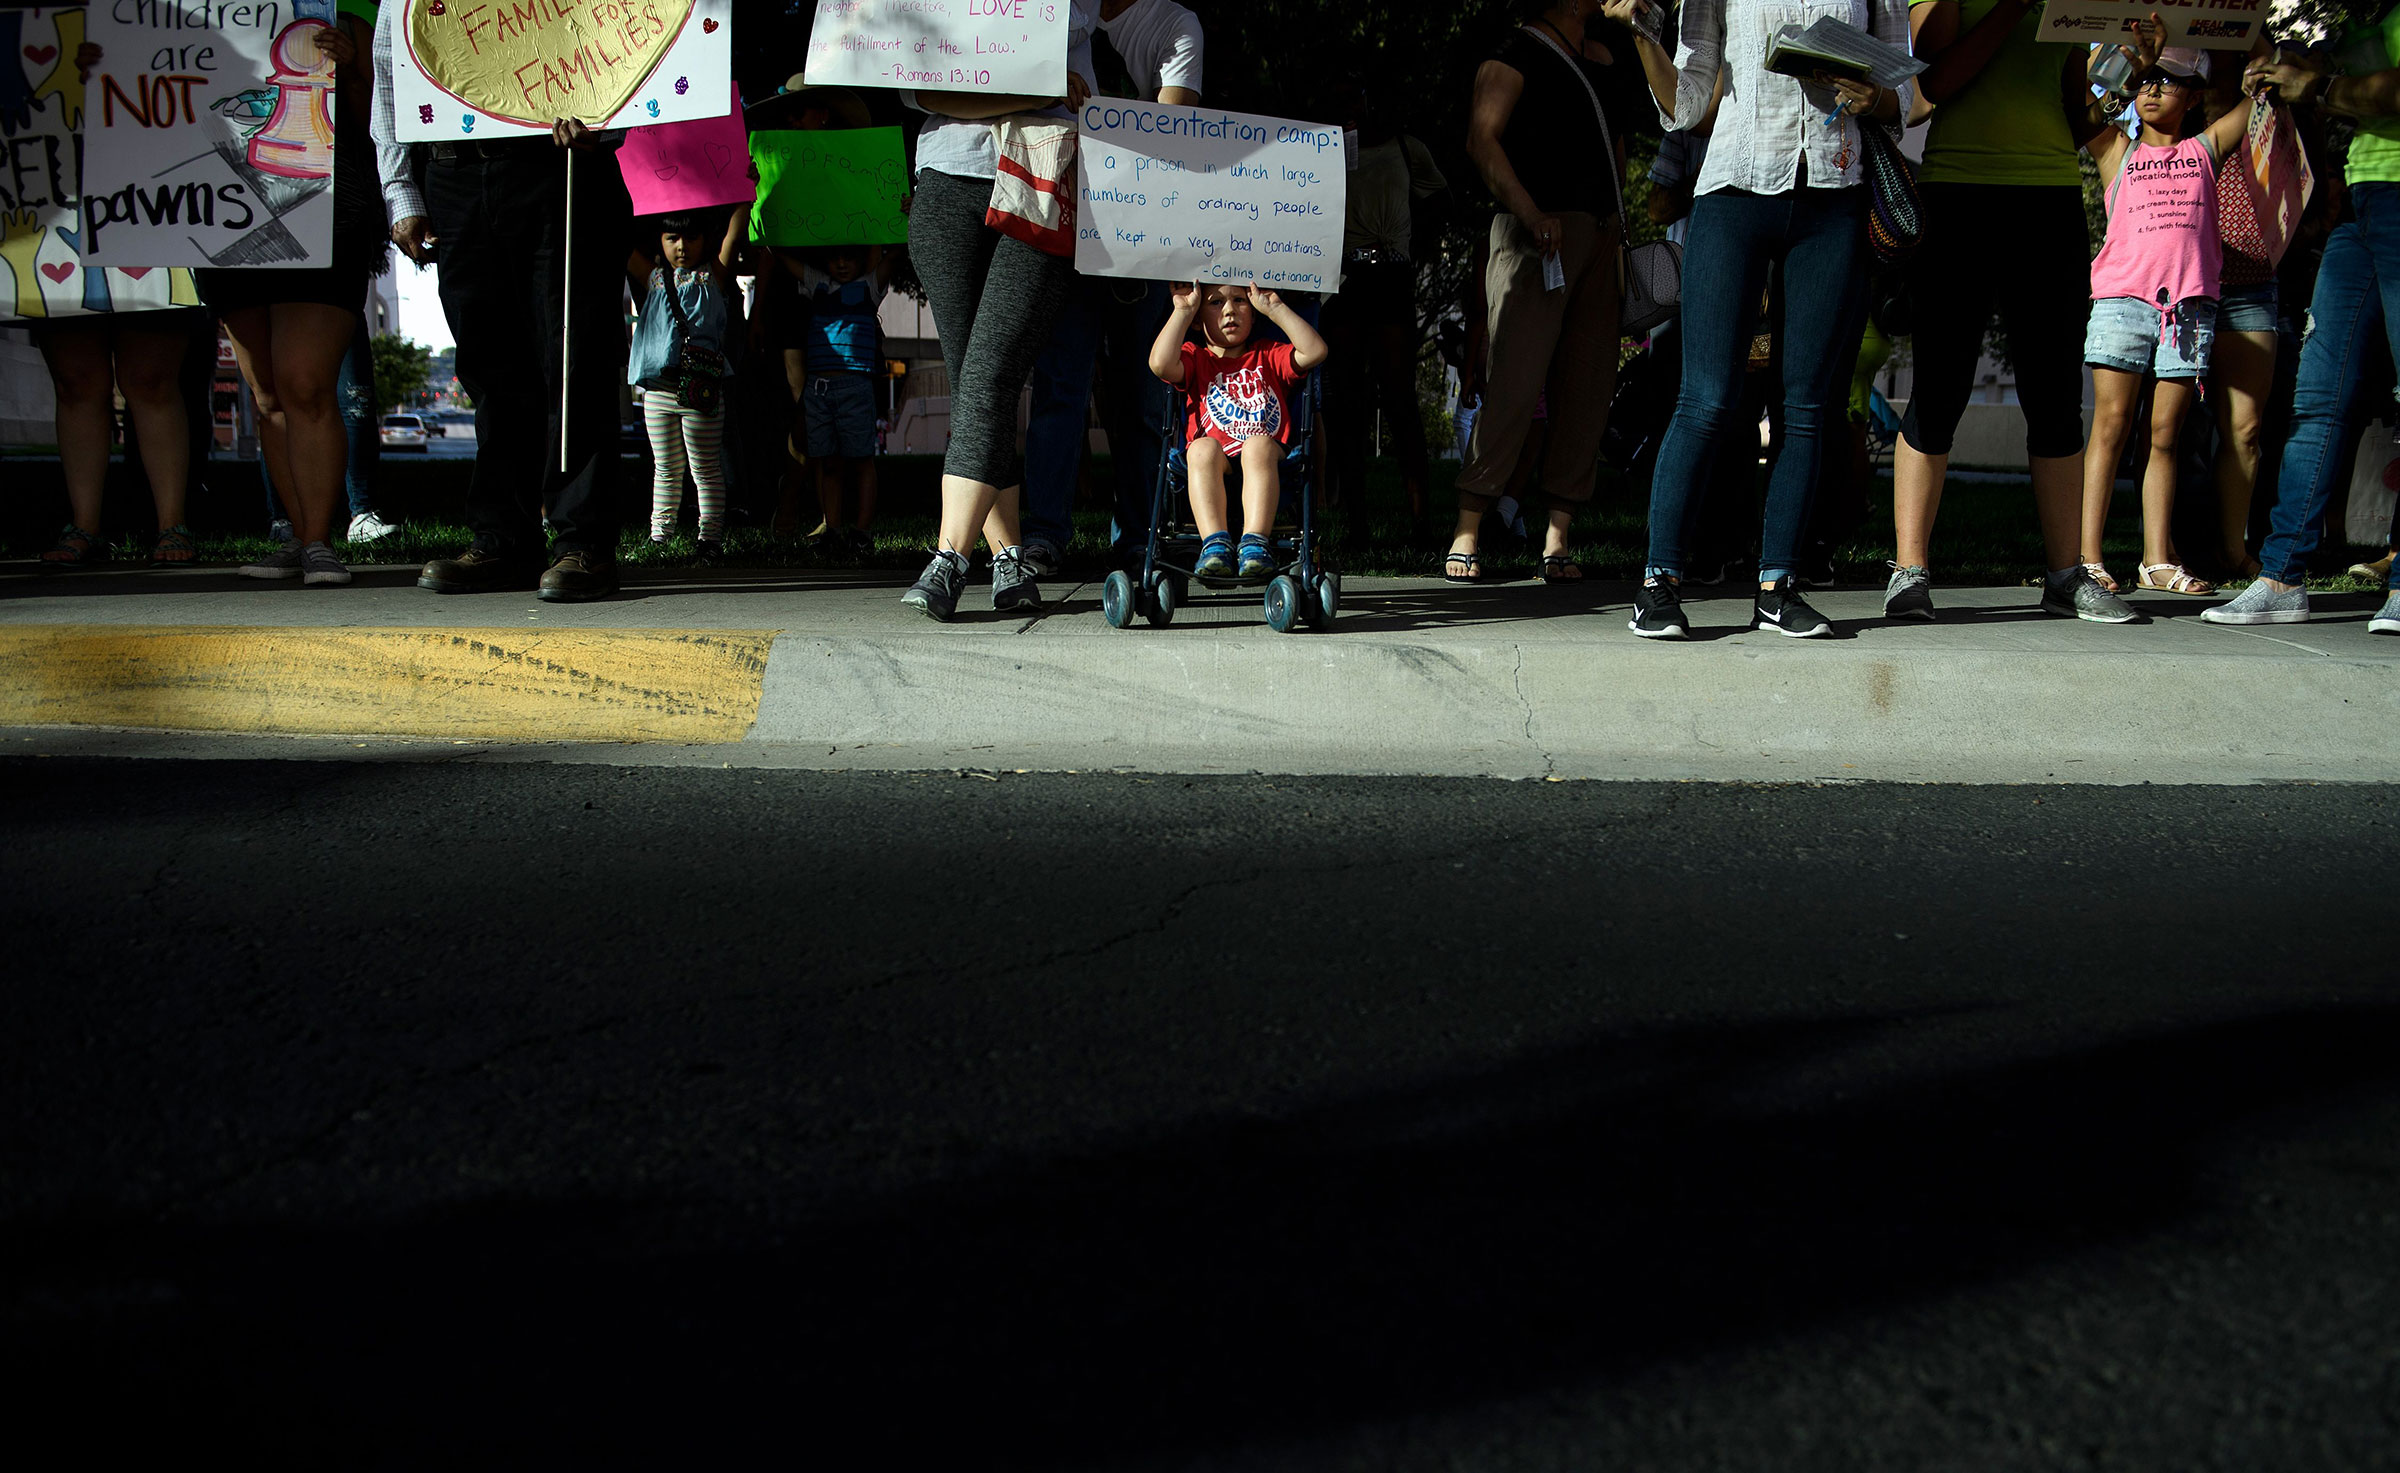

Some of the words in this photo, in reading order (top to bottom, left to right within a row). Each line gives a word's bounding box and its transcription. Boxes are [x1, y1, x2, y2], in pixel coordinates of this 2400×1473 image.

[969, 0, 1025, 19] LOVE
[1039, 4, 1056, 22] is
[459, 0, 582, 55] FAMIL
[2193, 27, 2242, 38] AMERICA
[2195, 19, 2225, 28] HEAL
[810, 36, 828, 51] the
[840, 34, 903, 52] fulfillment
[914, 37, 928, 53] of
[938, 38, 963, 55] the
[150, 43, 218, 73] are
[513, 4, 666, 110] FAMILIES
[950, 69, 990, 85] 13:10
[101, 73, 209, 129] NOT
[1104, 155, 1116, 169] a
[1135, 153, 1186, 181] prison
[1203, 159, 1217, 176] in
[1230, 161, 1269, 180] which
[1281, 164, 1321, 188] large
[2126, 157, 2203, 175] summer
[2172, 169, 2204, 180] mode]
[2155, 188, 2170, 196] lazy
[2171, 188, 2188, 196] days
[1082, 187, 1147, 206] numbers
[1161, 190, 1179, 208] of
[1198, 198, 1259, 221] ordinary
[1272, 200, 1324, 217] people
[2135, 202, 2145, 211] ice
[2146, 200, 2168, 208] cream
[82, 182, 254, 255] pawns
[2157, 211, 2187, 219] sunshine
[2174, 222, 2196, 231] friends
[1079, 227, 1101, 241] are
[1159, 235, 1171, 247] in
[1230, 233, 1253, 252] bad
[1263, 270, 1323, 289] dictionary
